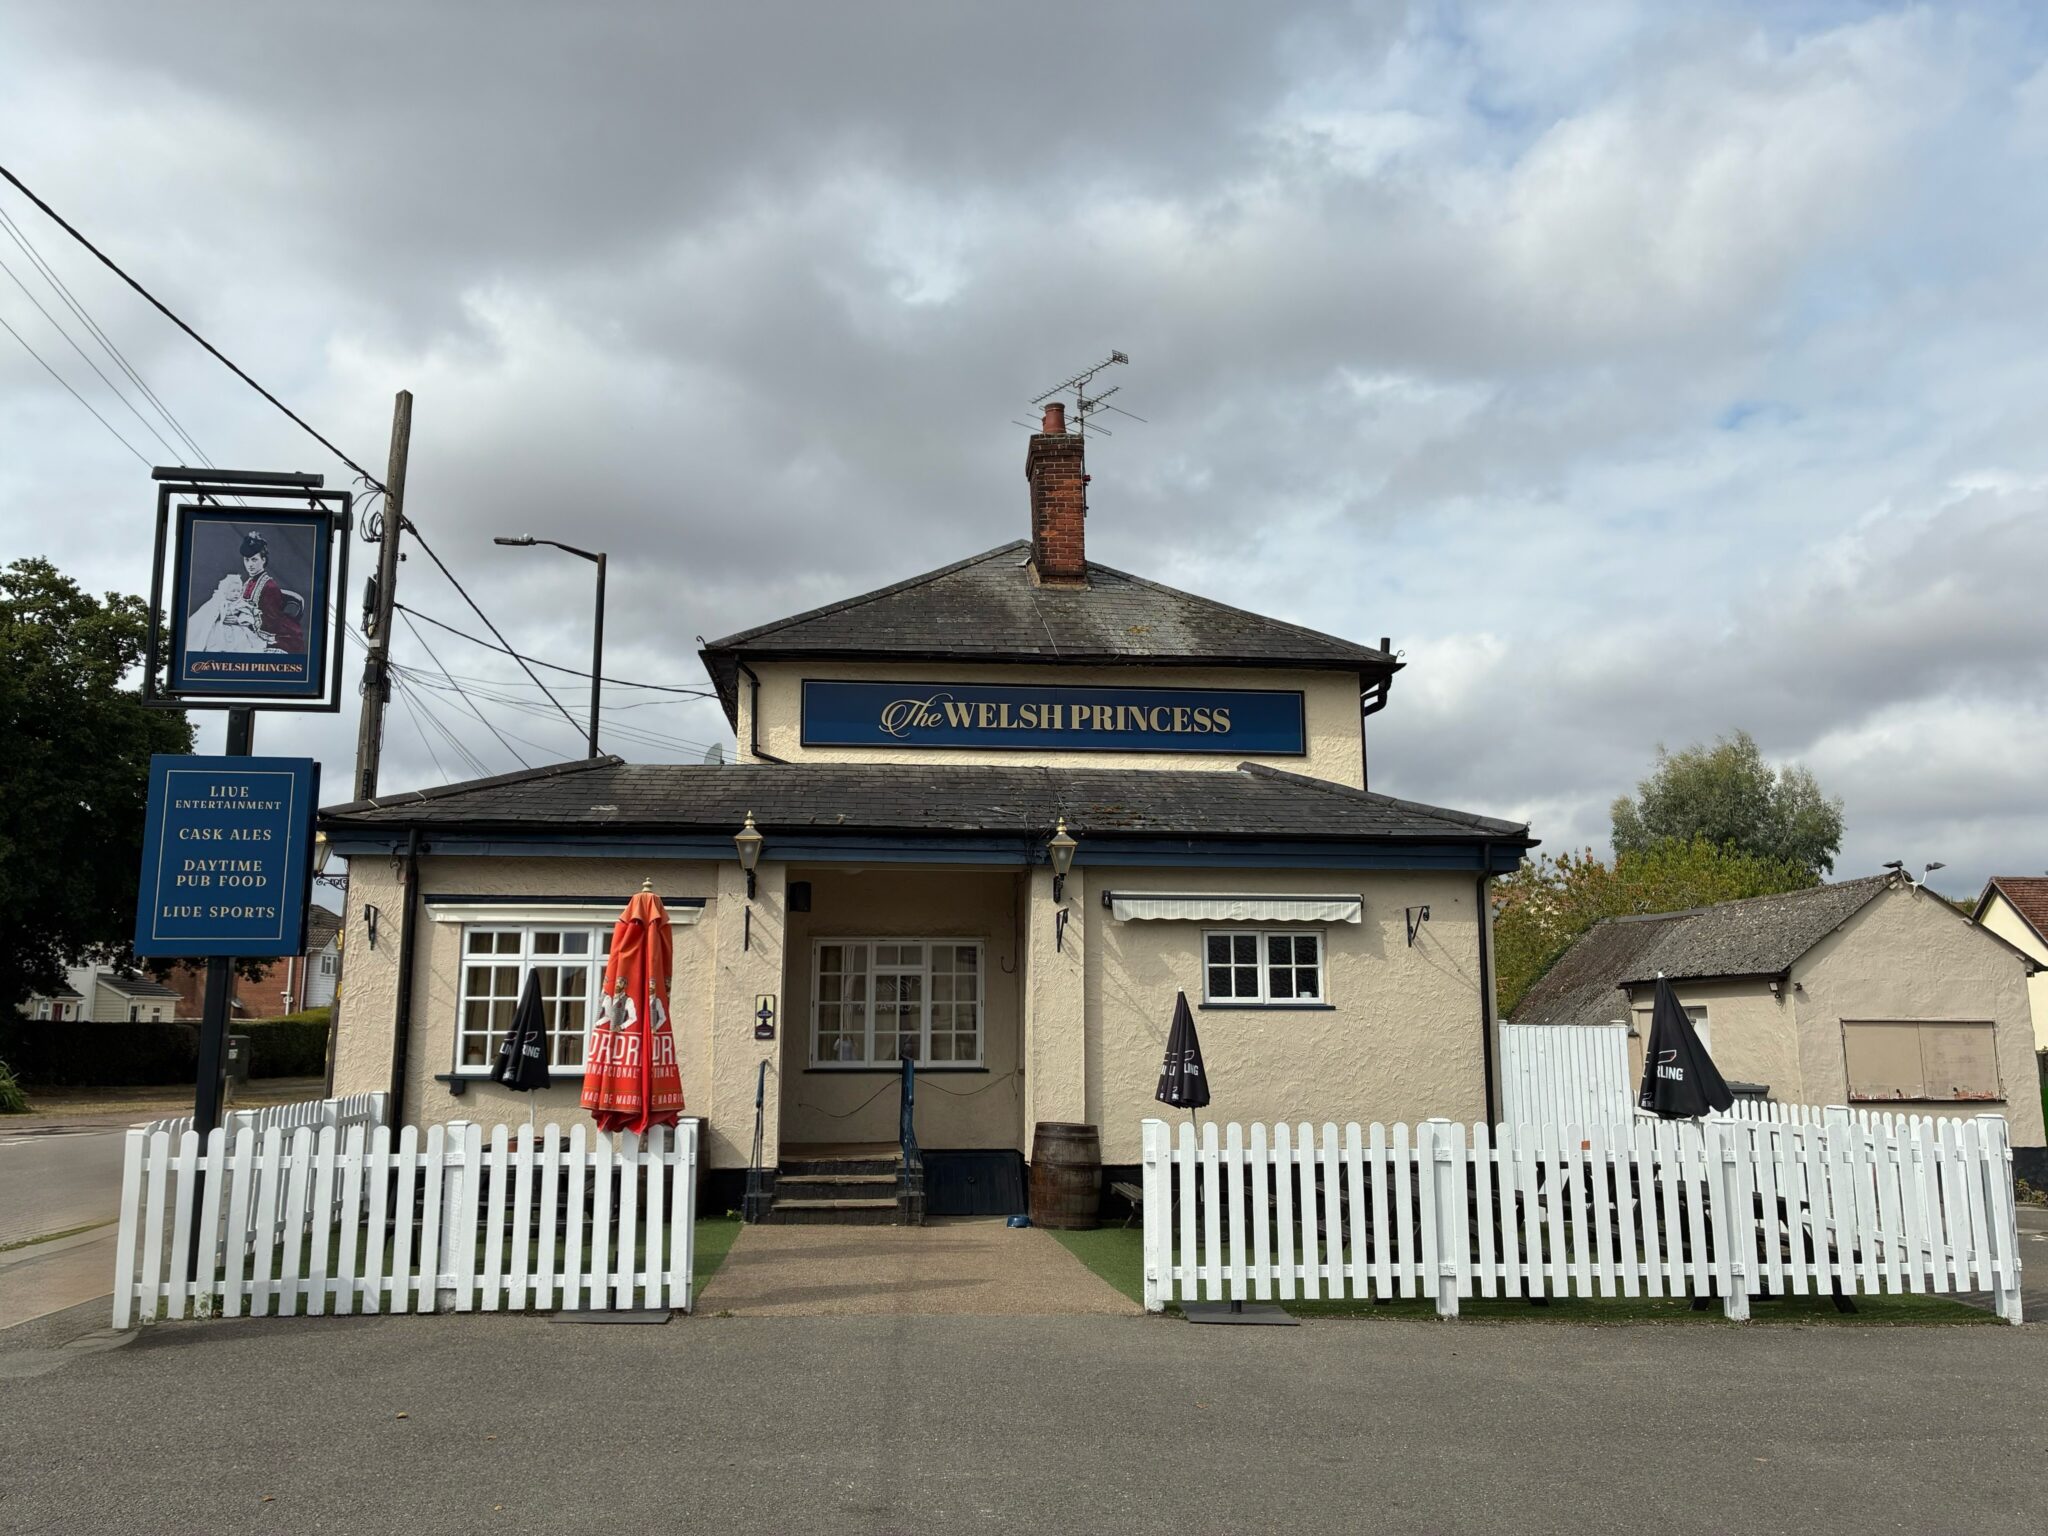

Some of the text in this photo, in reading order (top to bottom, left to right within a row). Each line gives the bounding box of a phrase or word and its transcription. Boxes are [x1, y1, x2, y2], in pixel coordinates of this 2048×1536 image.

[190, 660, 303, 673] The WELSH PRINCESS
[878, 692, 1232, 738] The WELSH PRINCESS
[210, 786, 249, 798] LIVE
[175, 800, 282, 810] ENTERTAINMENT
[179, 828, 272, 841] CASK ALES
[184, 860, 263, 872] DAYTIME
[176, 875, 267, 887] PUB FOOD
[163, 906, 275, 919] LIVE SPORTS
